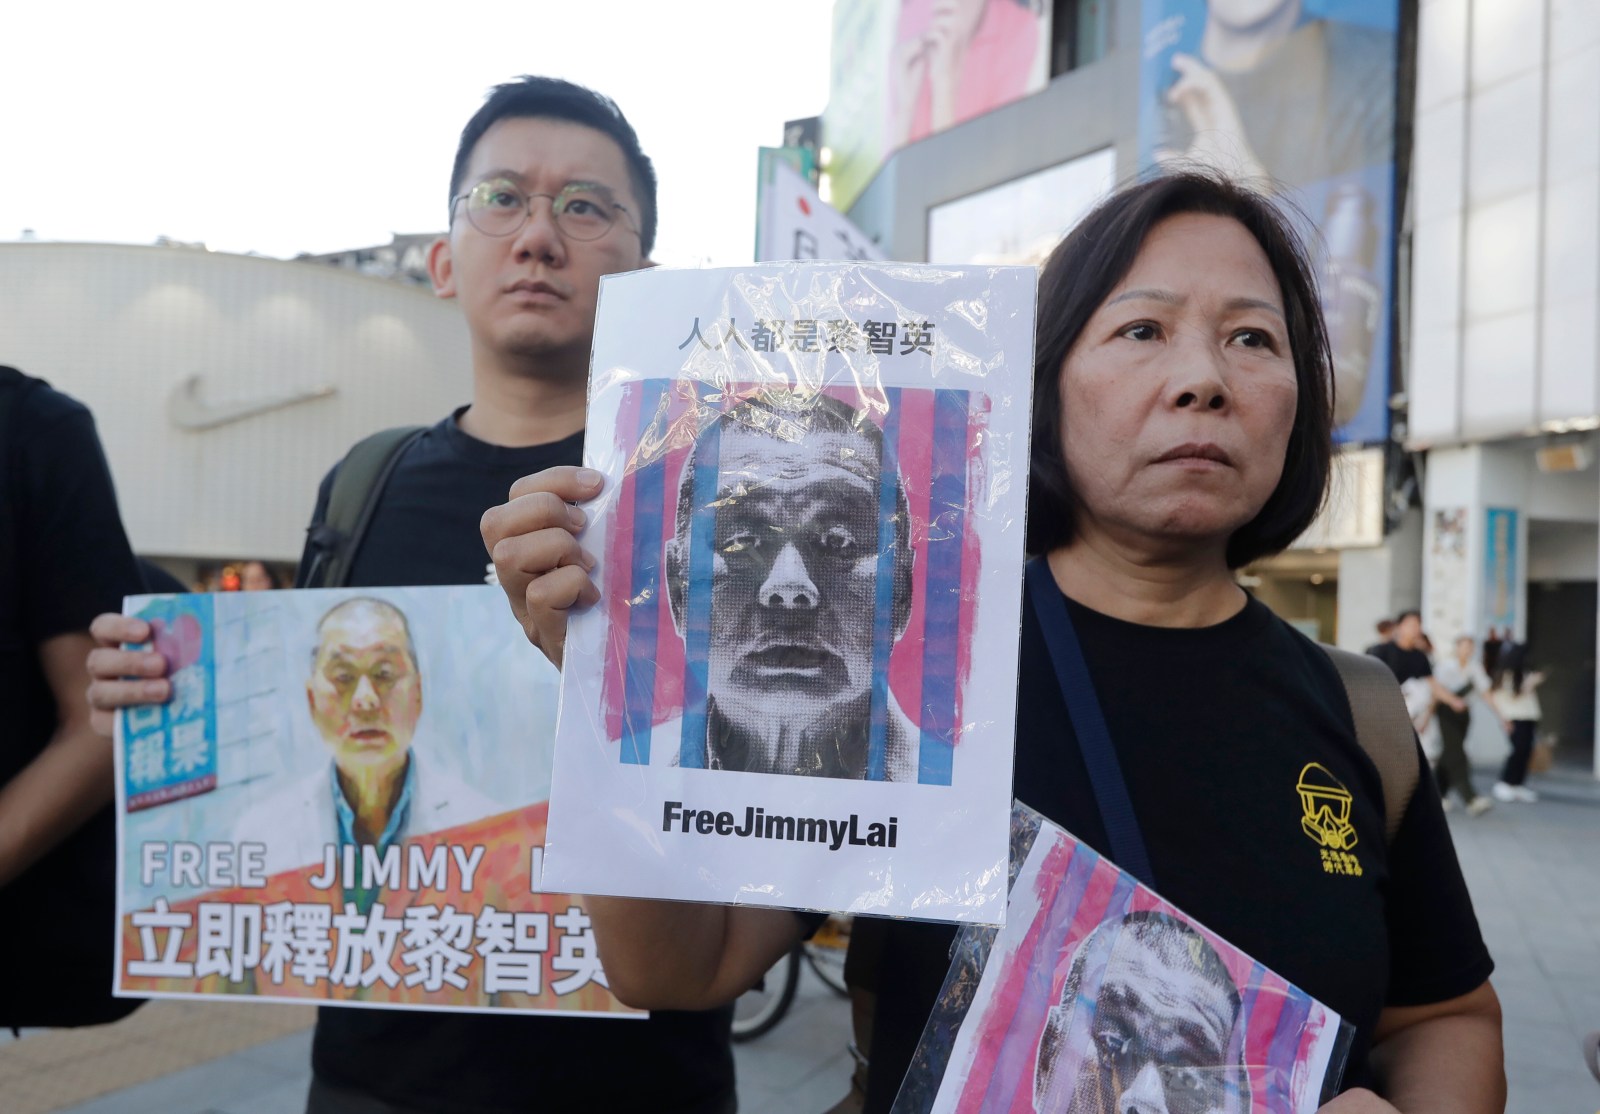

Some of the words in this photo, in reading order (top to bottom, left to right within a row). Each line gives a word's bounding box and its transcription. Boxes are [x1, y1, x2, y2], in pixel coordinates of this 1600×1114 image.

[678, 316, 936, 356] 人人都是黎智英
[662, 801, 898, 851] FreeJimmyLai
[141, 842, 267, 888] FREE
[309, 844, 486, 892] JIMMY
[126, 898, 610, 996] 立即釋放黎智英
